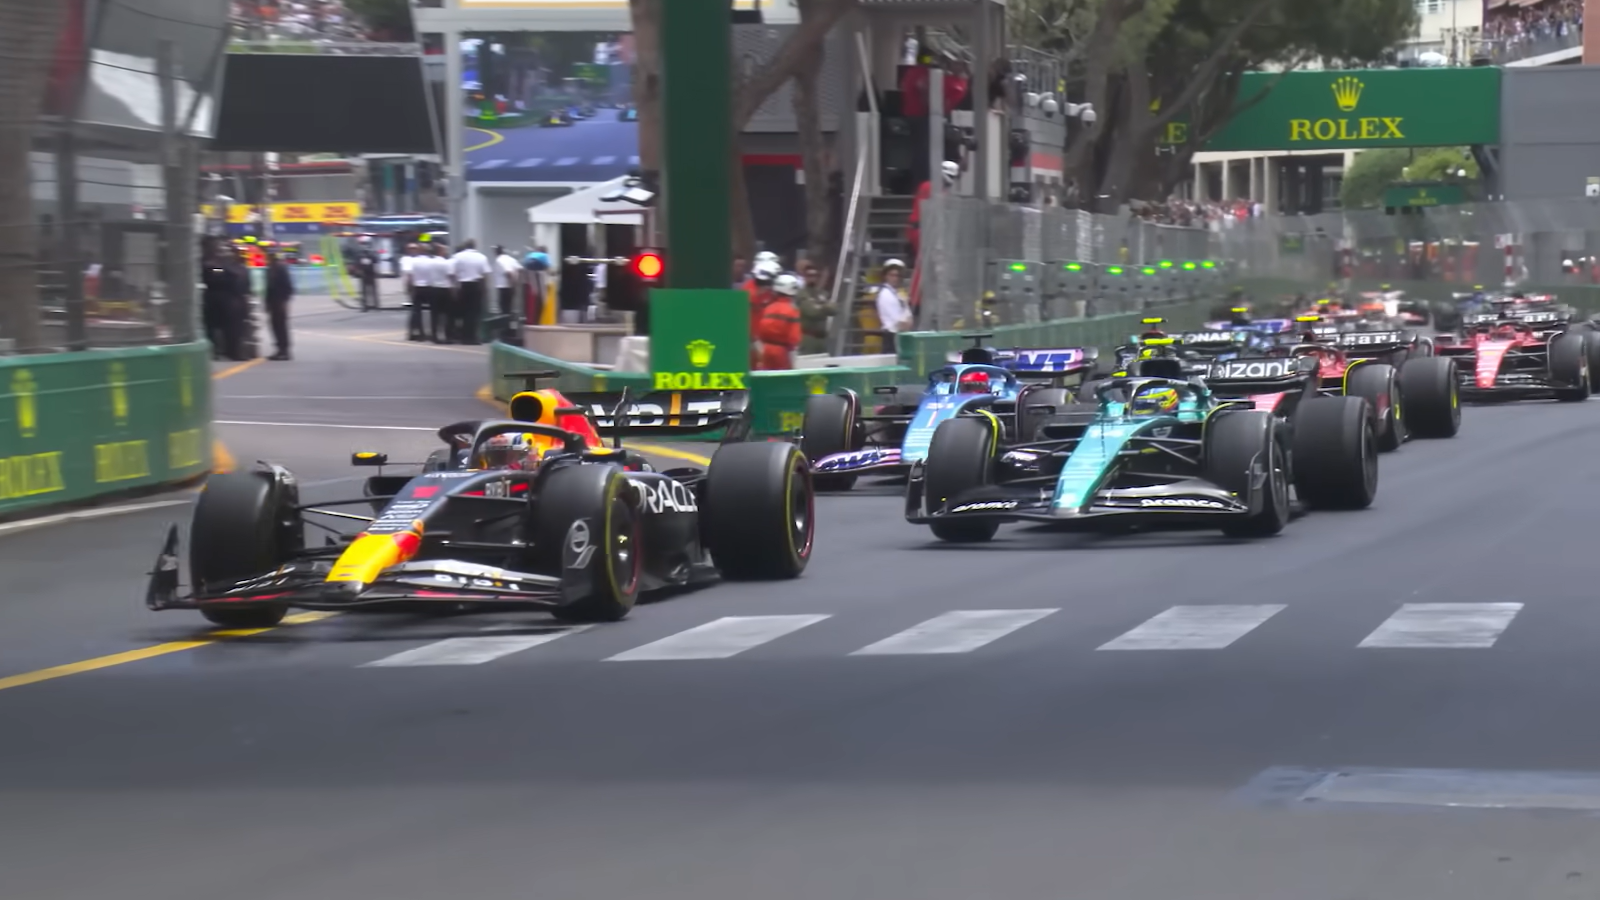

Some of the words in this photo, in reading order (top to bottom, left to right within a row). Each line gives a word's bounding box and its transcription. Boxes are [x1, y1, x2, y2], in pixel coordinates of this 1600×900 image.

[1289, 117, 1406, 141] ROLEX
[654, 372, 746, 389] ROLEX
[952, 501, 1018, 512] aramco
[1141, 498, 1224, 508] aramco
